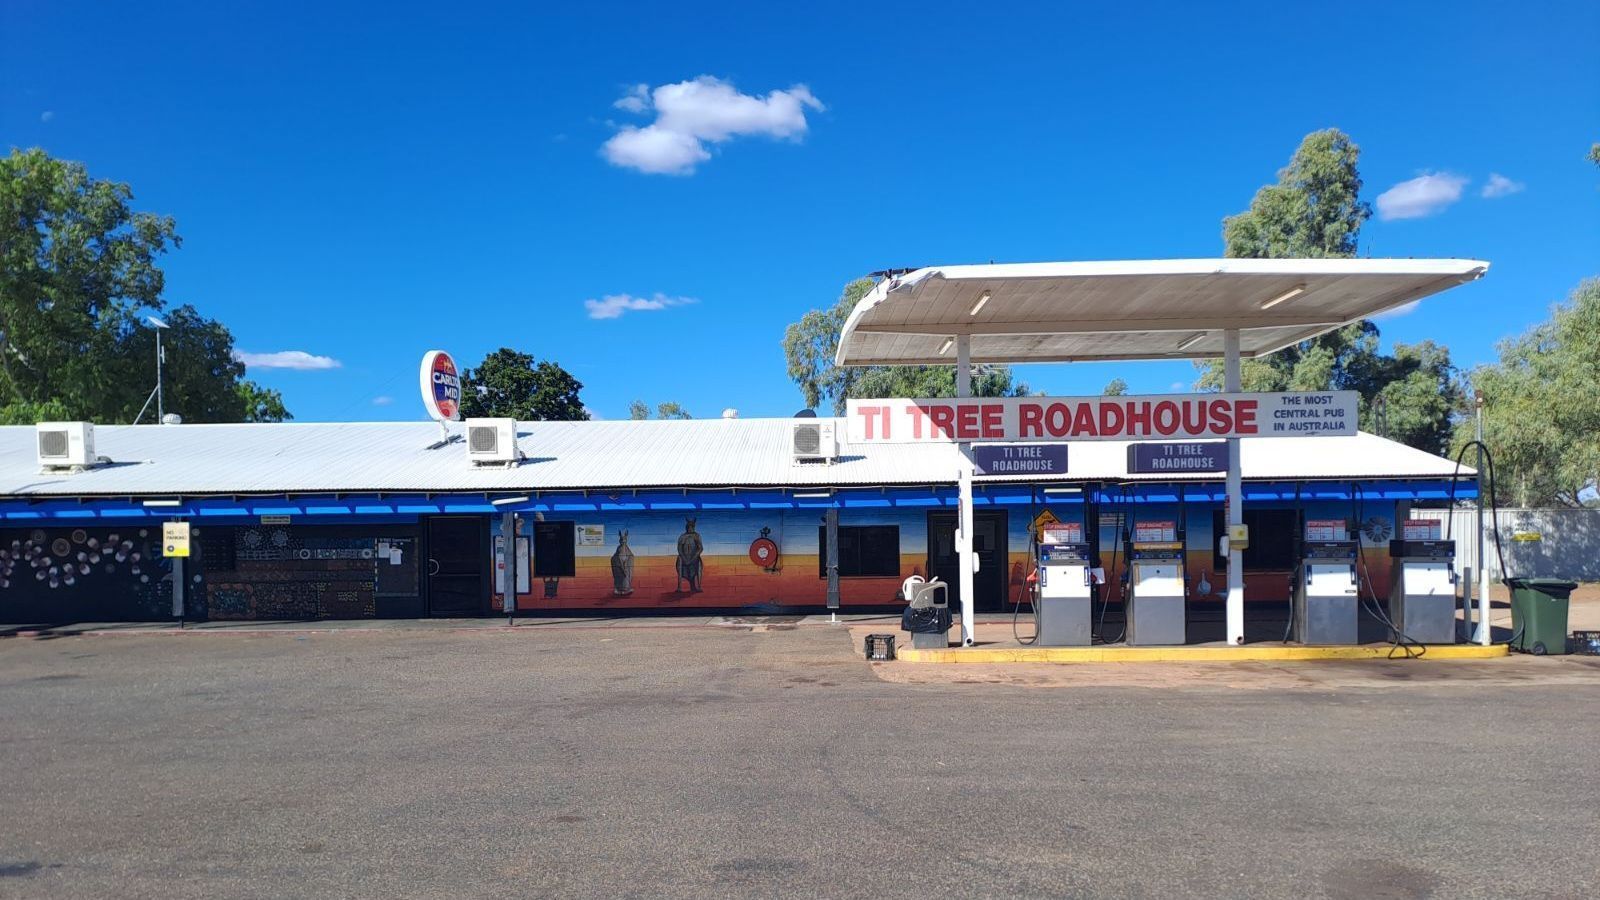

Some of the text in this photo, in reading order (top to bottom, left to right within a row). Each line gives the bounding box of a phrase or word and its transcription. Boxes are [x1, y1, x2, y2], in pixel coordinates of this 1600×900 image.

[444, 386, 458, 399] MID
[1281, 395, 1334, 405] THE MOST
[857, 399, 1258, 440] TI TREE ROADHOUSE
[1273, 408, 1345, 419] CENTRAL PUB
[1273, 421, 1346, 431] IN AUSTRALIA
[1003, 446, 1042, 458] TI TREE
[1163, 444, 1203, 455] TI TREE
[992, 459, 1053, 471] ROADHOUSE
[1151, 457, 1214, 469] ROADHOUSE
